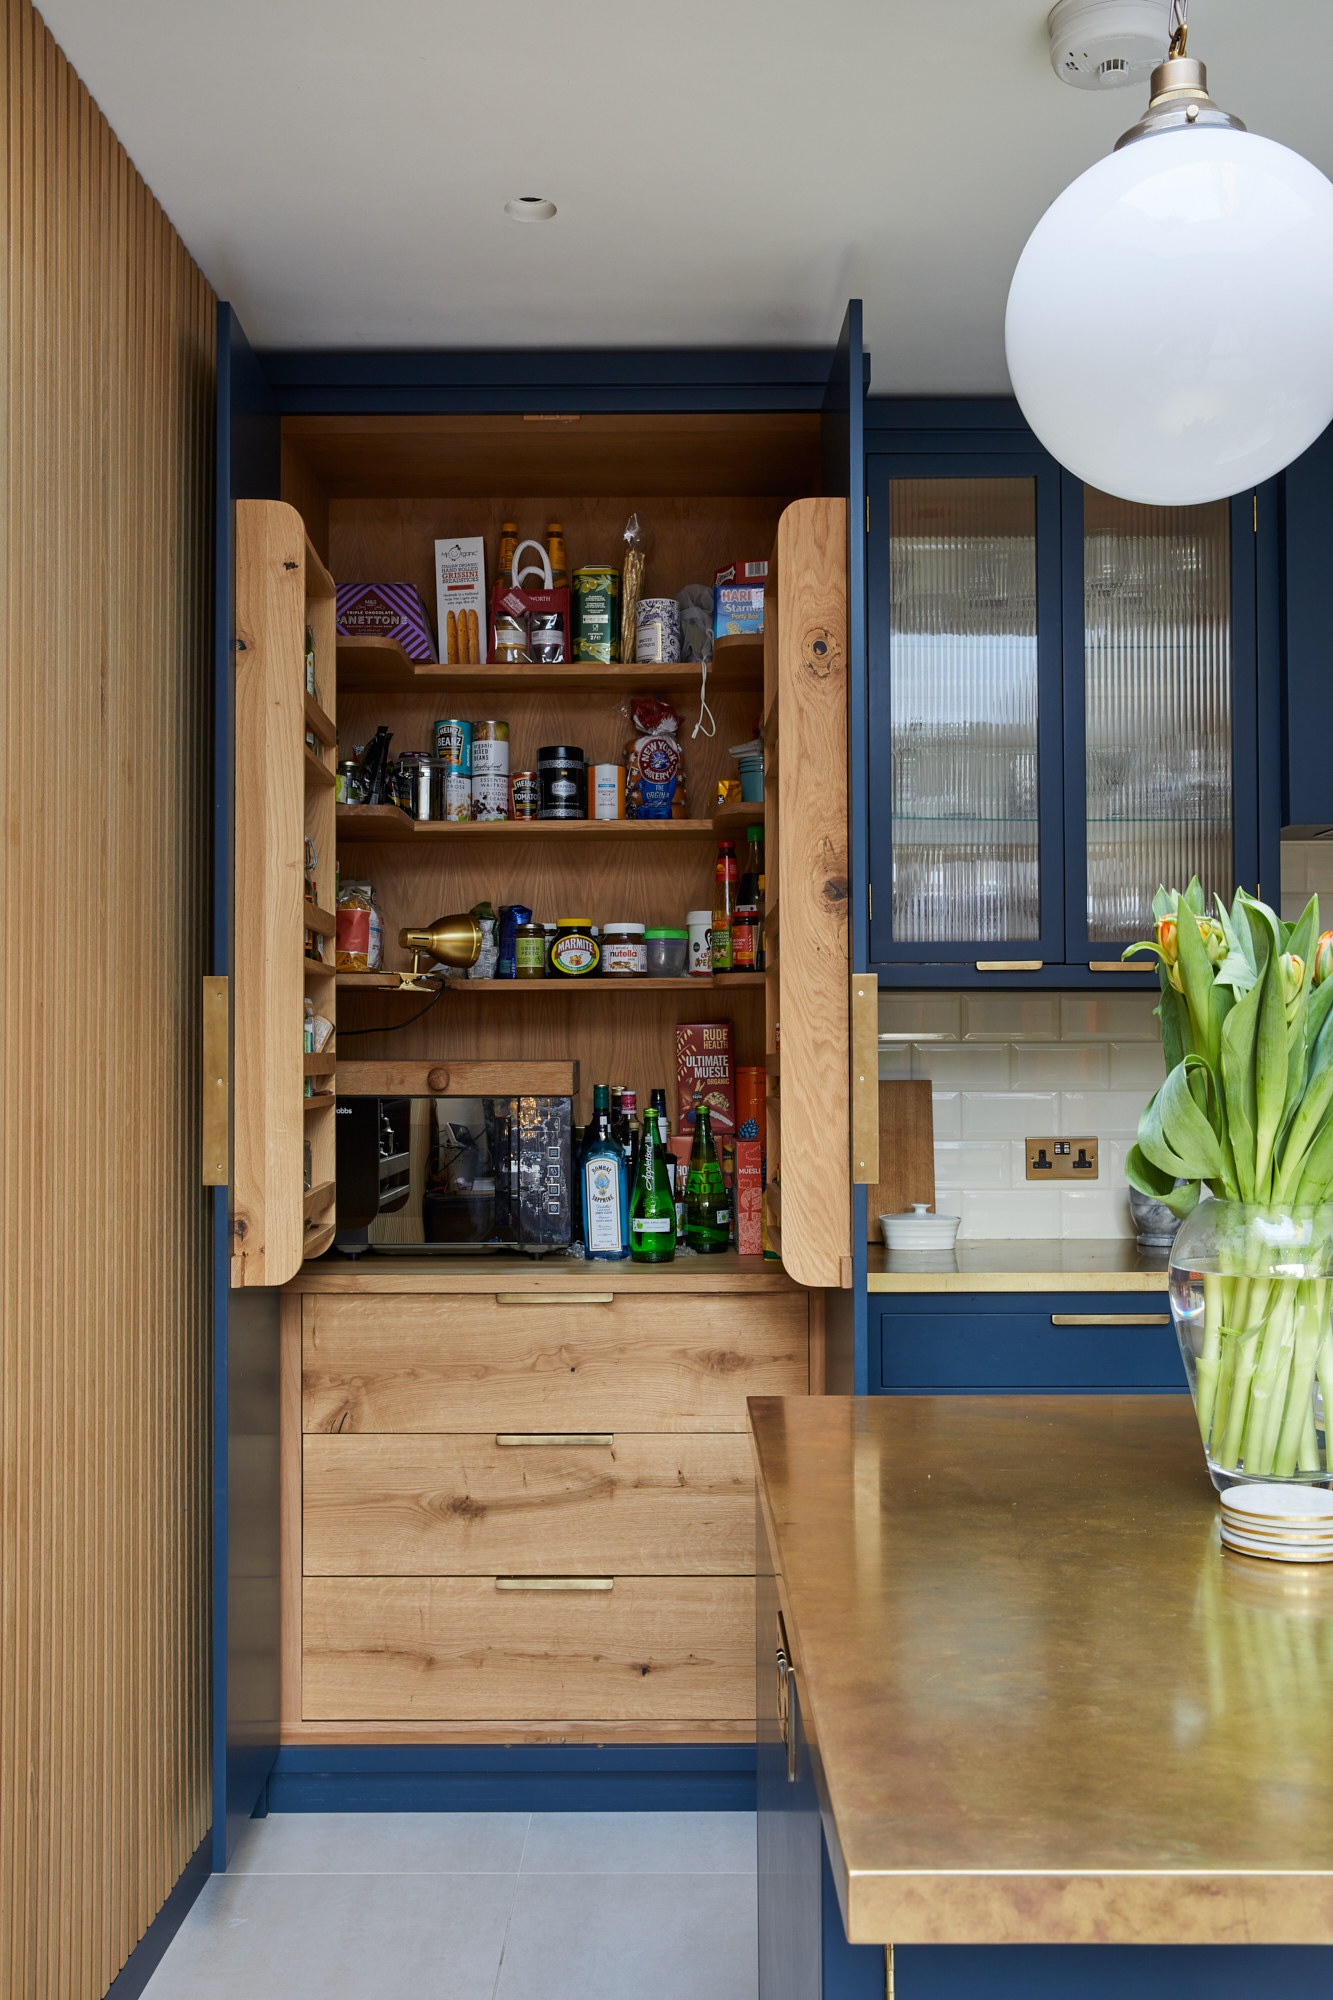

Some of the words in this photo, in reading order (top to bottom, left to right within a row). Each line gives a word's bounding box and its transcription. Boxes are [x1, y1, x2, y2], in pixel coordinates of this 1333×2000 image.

[442, 571, 479, 579] GRISSINI
[440, 726, 458, 736] HEINZ
[438, 737, 462, 746] BEANZ
[642, 742, 657, 762] NEW
[658, 741, 678, 762] YORK
[644, 768, 670, 780] BAKERY
[516, 780, 536, 788] HEINZ
[558, 938, 594, 953] MARMITE
[703, 1029, 728, 1041] RUDE
[704, 1041, 728, 1049] HEALTH
[686, 1056, 729, 1067] ULTIMATE
[694, 1066, 729, 1078] MUESLI
[592, 1165, 612, 1175] BOMBAY
[642, 1144, 655, 1191] Appletiser
[592, 1194, 615, 1203] SAPPHIRE
